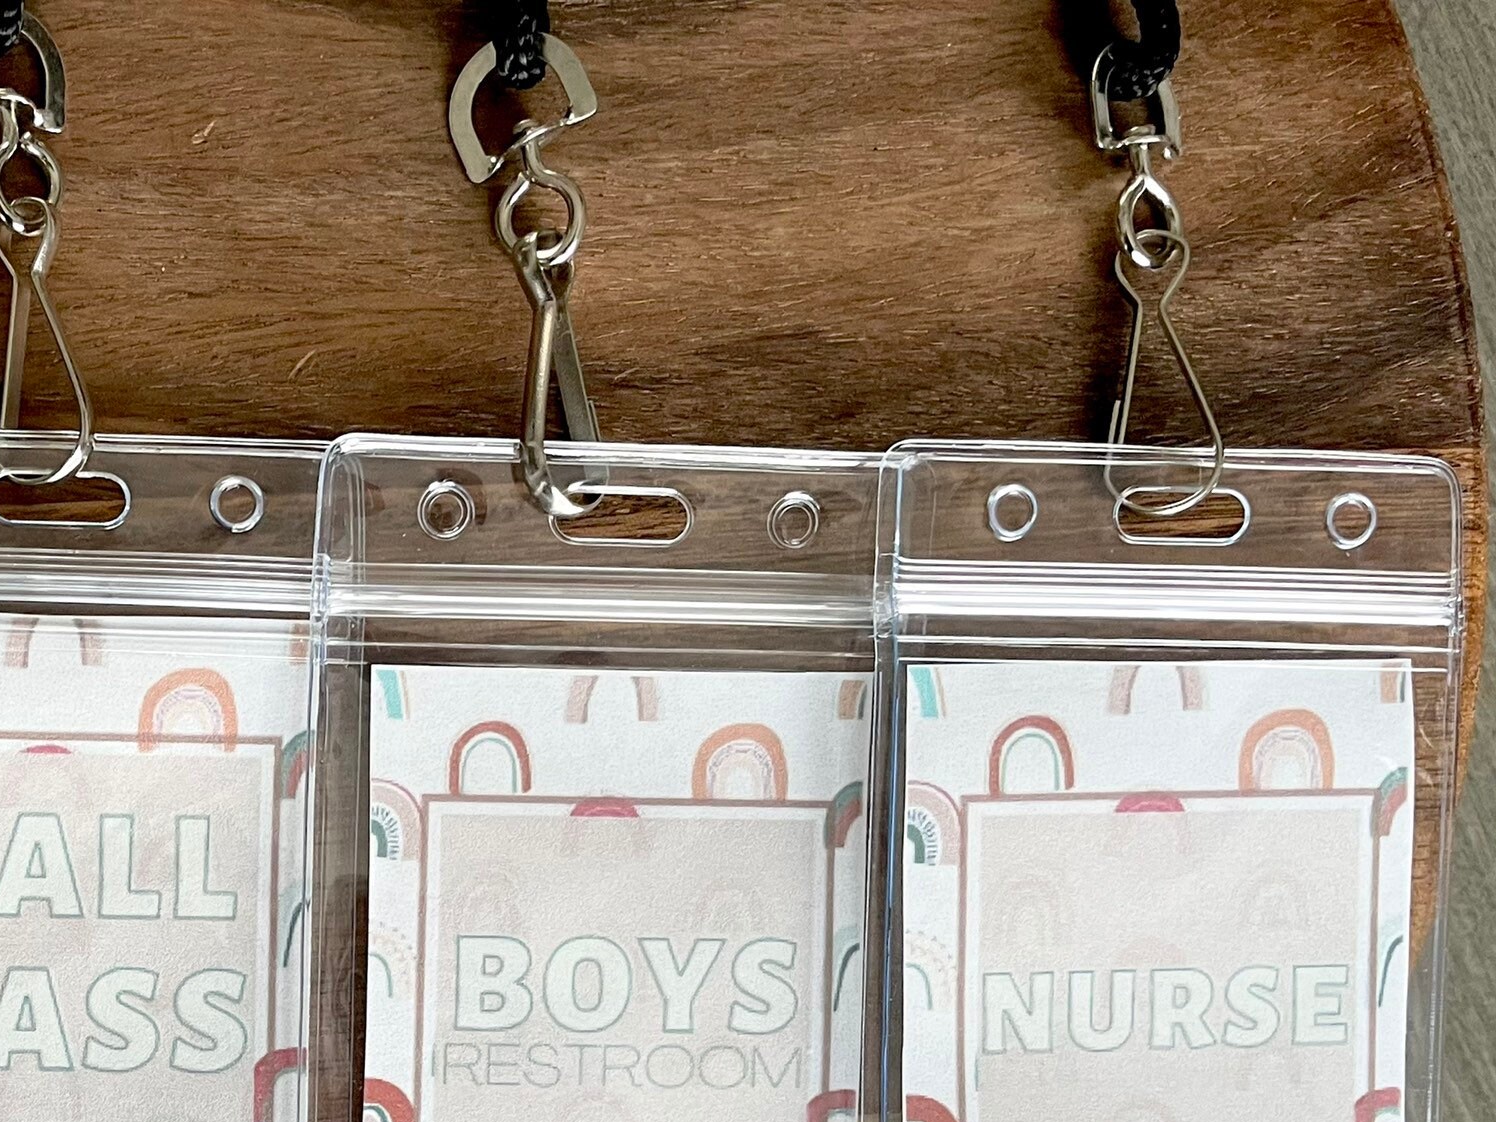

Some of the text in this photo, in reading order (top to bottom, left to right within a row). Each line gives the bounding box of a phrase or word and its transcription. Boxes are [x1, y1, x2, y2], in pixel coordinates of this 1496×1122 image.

[454, 934, 799, 1034] BOYS
[982, 964, 1349, 1055] NURSE
[440, 1040, 804, 1090] RESTROOM
